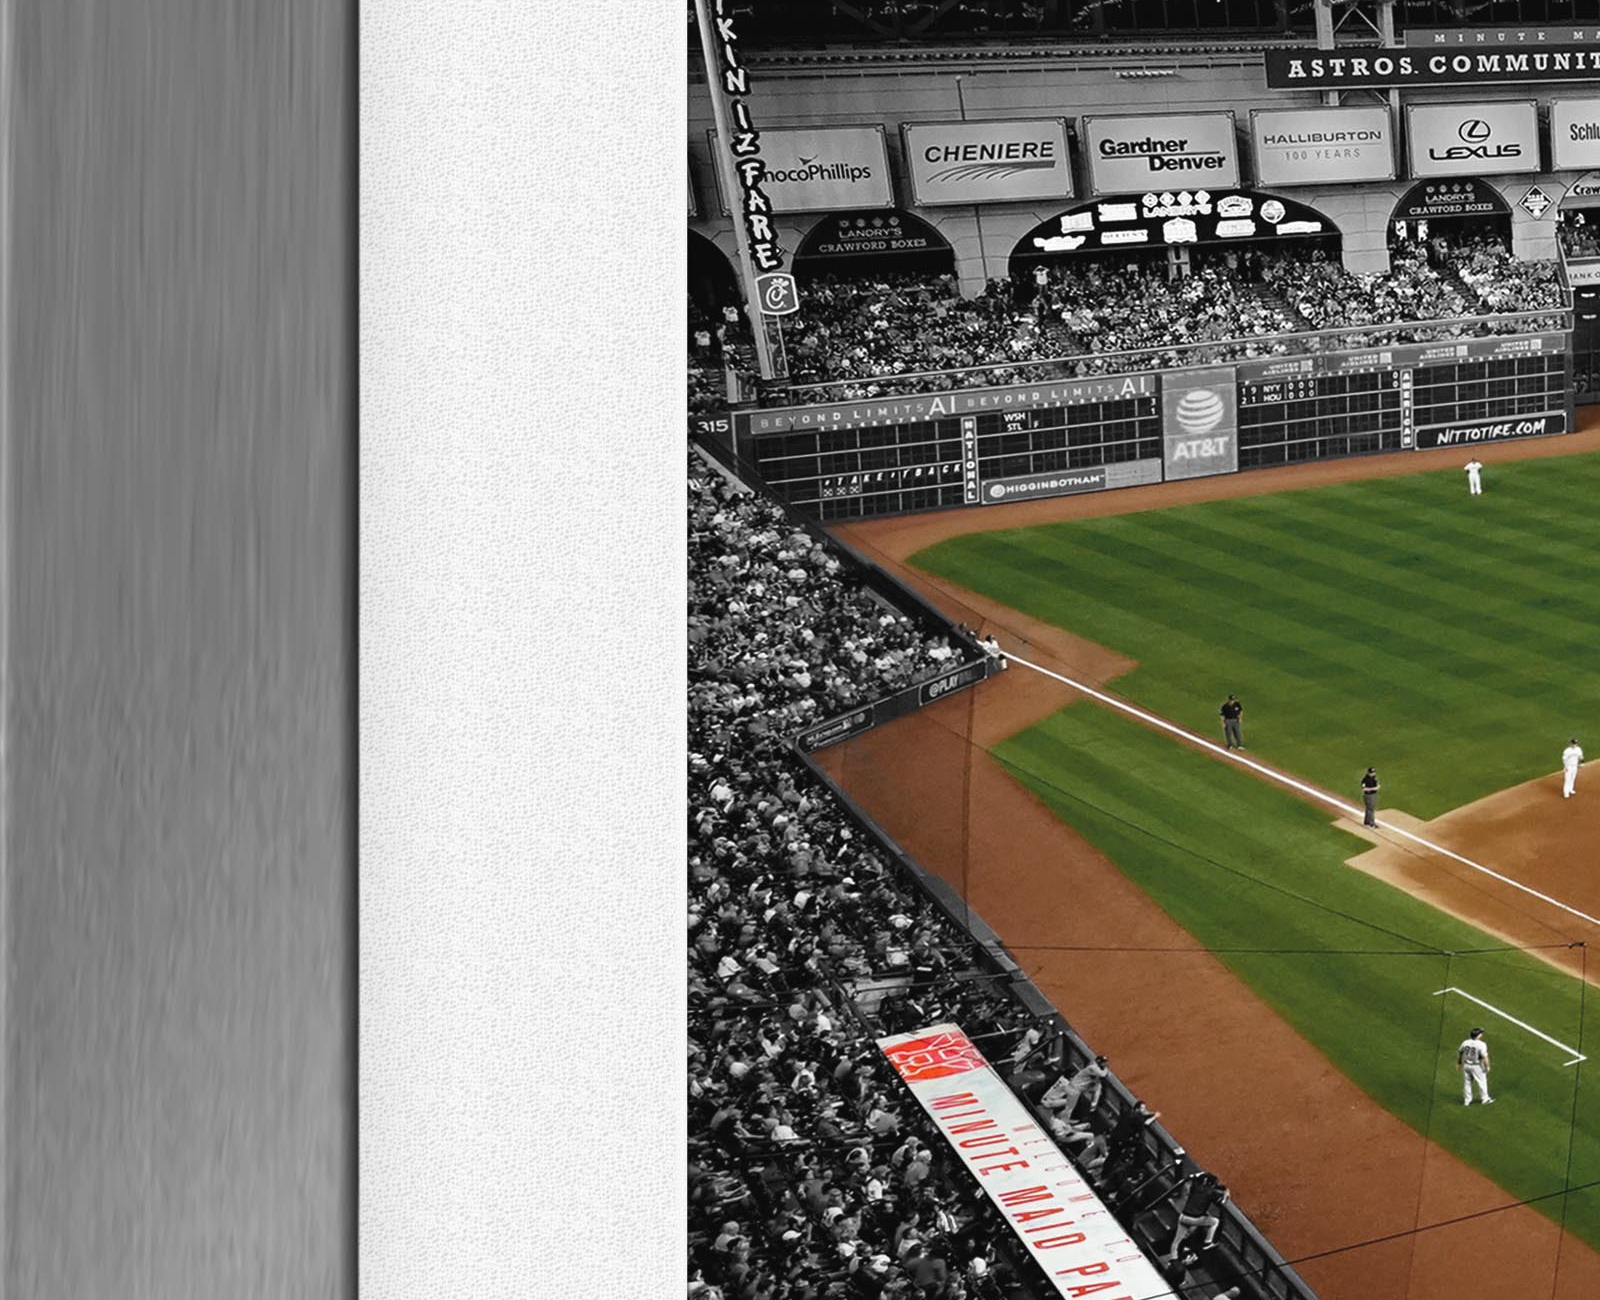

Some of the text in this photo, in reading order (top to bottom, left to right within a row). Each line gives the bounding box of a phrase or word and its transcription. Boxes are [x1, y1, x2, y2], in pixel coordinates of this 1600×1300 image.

[1435, 31, 1546, 43] MINUTE
[1263, 130, 1382, 145] HALLIBURTON
[924, 141, 1055, 164] CHENIERE
[1099, 138, 1189, 156] Gardner
[1285, 148, 1361, 160] 100 YEARS
[1429, 143, 1521, 161] LEXUS
[1149, 153, 1227, 173] Denver
[1409, 203, 1493, 215] CRAWFORD BOXES
[838, 227, 902, 239] LANDRY'S
[819, 237, 927, 252] CRAWFORD BOXES
[968, 384, 1114, 408] BEYOND LIMITS
[761, 412, 840, 429] BEYOND
[854, 404, 924, 420] LIMITS
[1003, 413, 1026, 422] WSH
[1007, 423, 1023, 432] STL
[1437, 419, 1546, 445] NITTOTIRE.COM
[1173, 436, 1230, 461] AT&T
[1006, 475, 1100, 494] HIGGINBOTHAM
[929, 1092, 1030, 1176] MINUTE
[998, 1185, 1087, 1250] MAID
